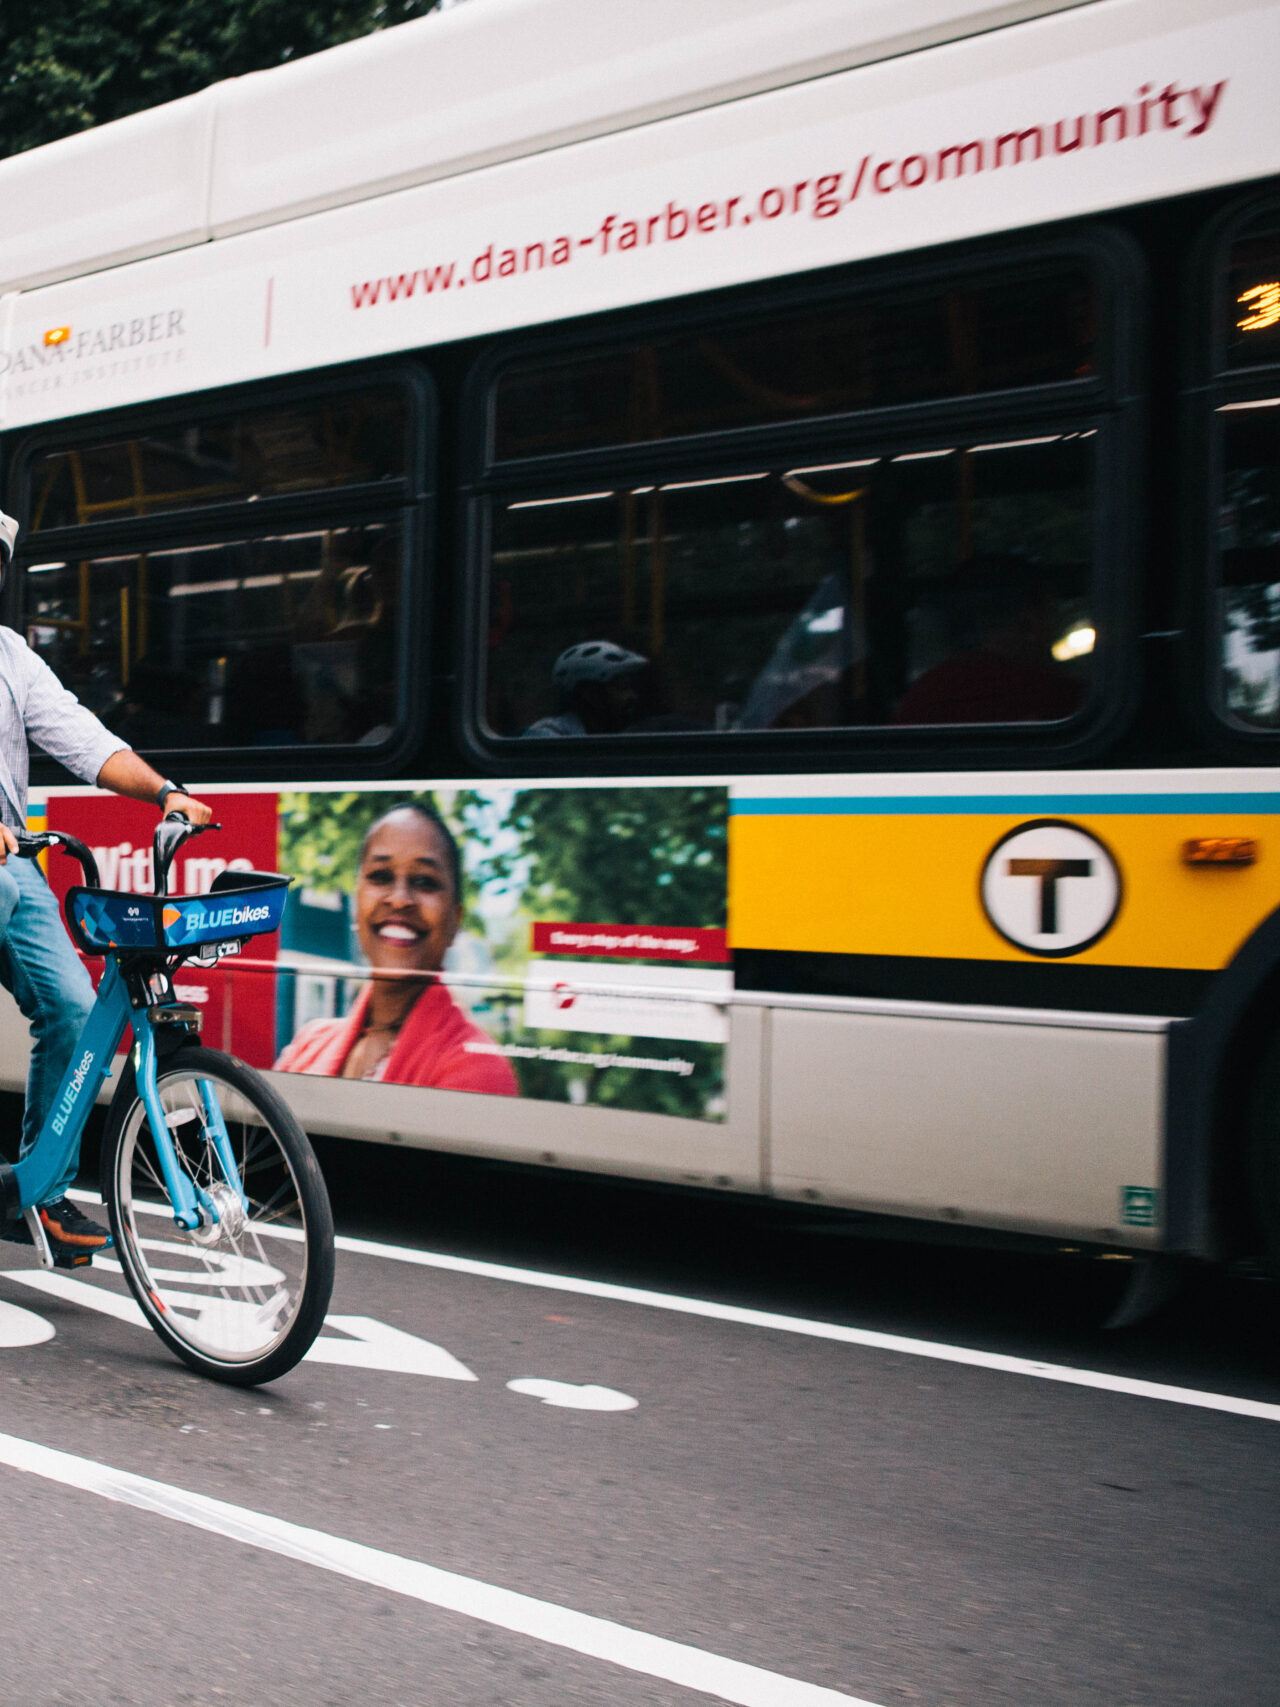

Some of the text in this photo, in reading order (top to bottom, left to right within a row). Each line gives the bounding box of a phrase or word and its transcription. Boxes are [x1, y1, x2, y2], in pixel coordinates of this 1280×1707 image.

[348, 77, 1228, 311] www.dana-farber.org/community
[185, 905, 270, 931] BLUEbikes
[1007, 858, 1092, 934] T
[51, 1050, 94, 1137] BLUEbikes
